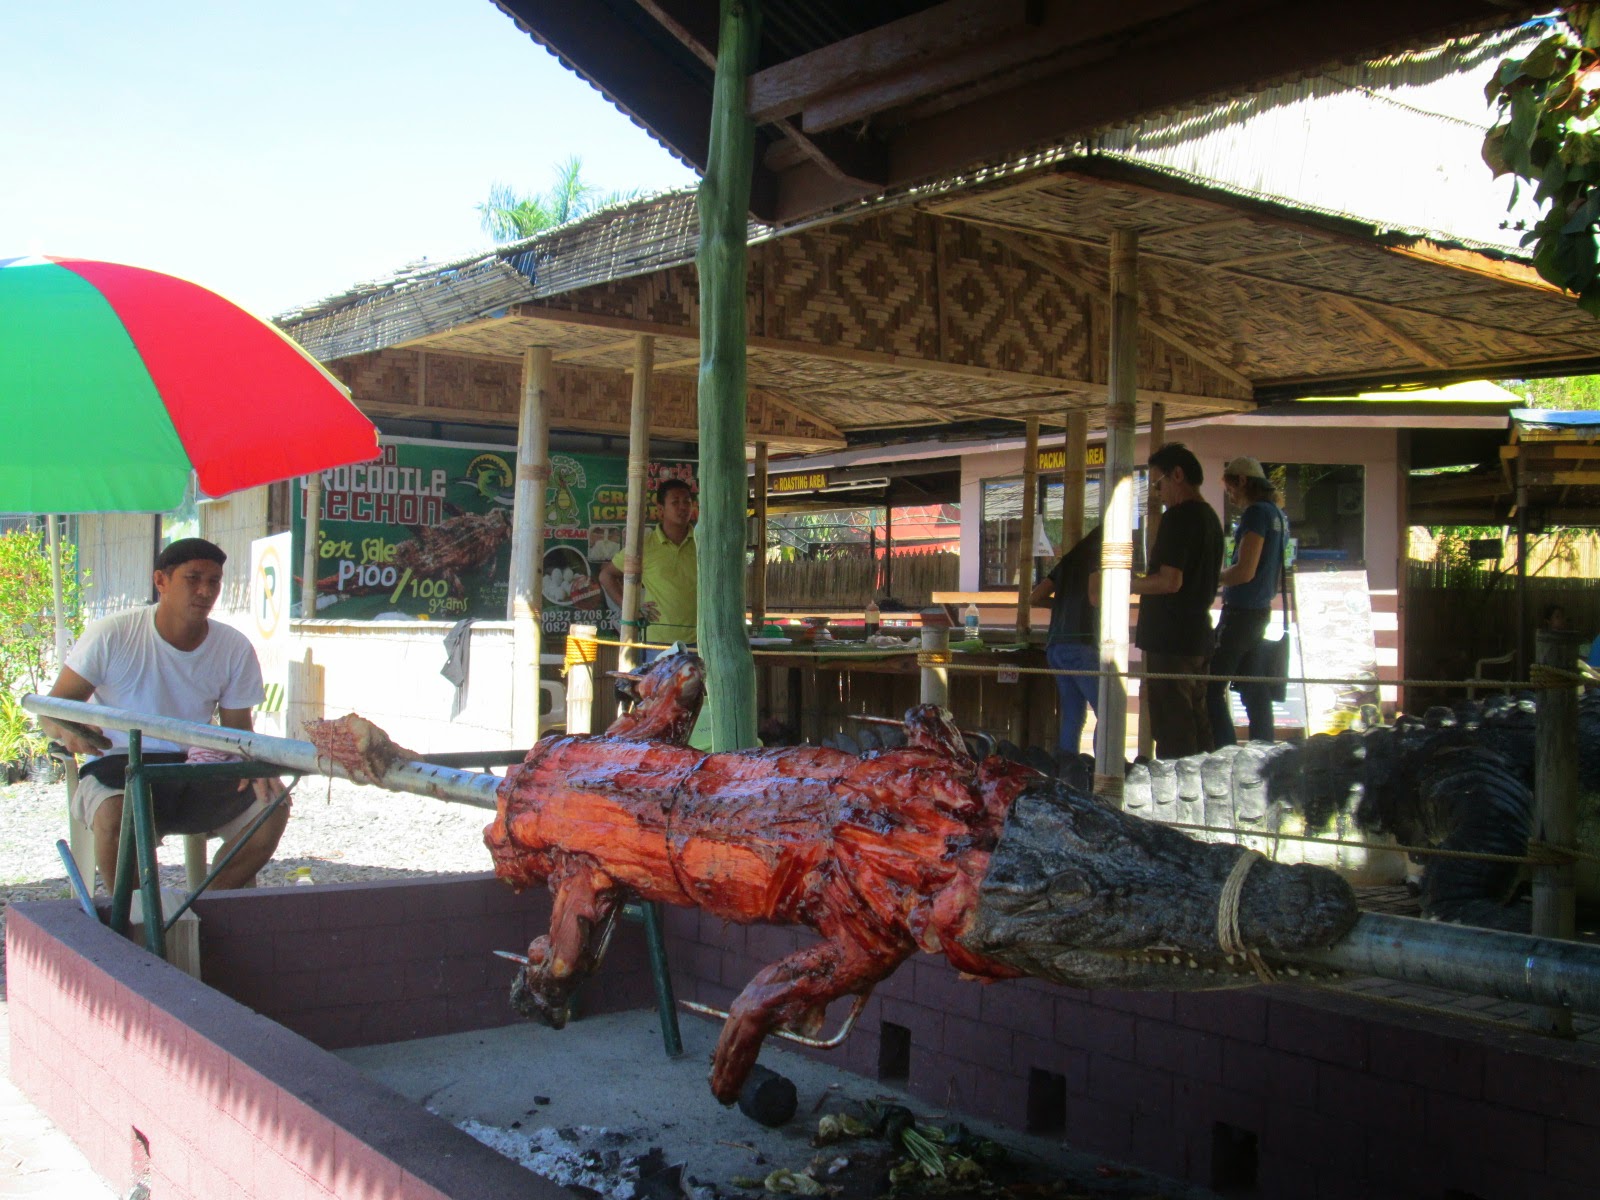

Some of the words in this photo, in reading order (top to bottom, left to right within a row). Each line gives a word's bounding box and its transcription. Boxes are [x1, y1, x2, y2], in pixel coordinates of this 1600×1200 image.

[779, 475, 808, 491] ROASTING
[809, 474, 826, 488] AREA
[592, 505, 629, 521] ICE
[555, 527, 588, 539] CREAM
[360, 537, 398, 565] sale
[428, 597, 468, 614] grams
[543, 611, 571, 622] 0932
[573, 609, 603, 620] 8708
